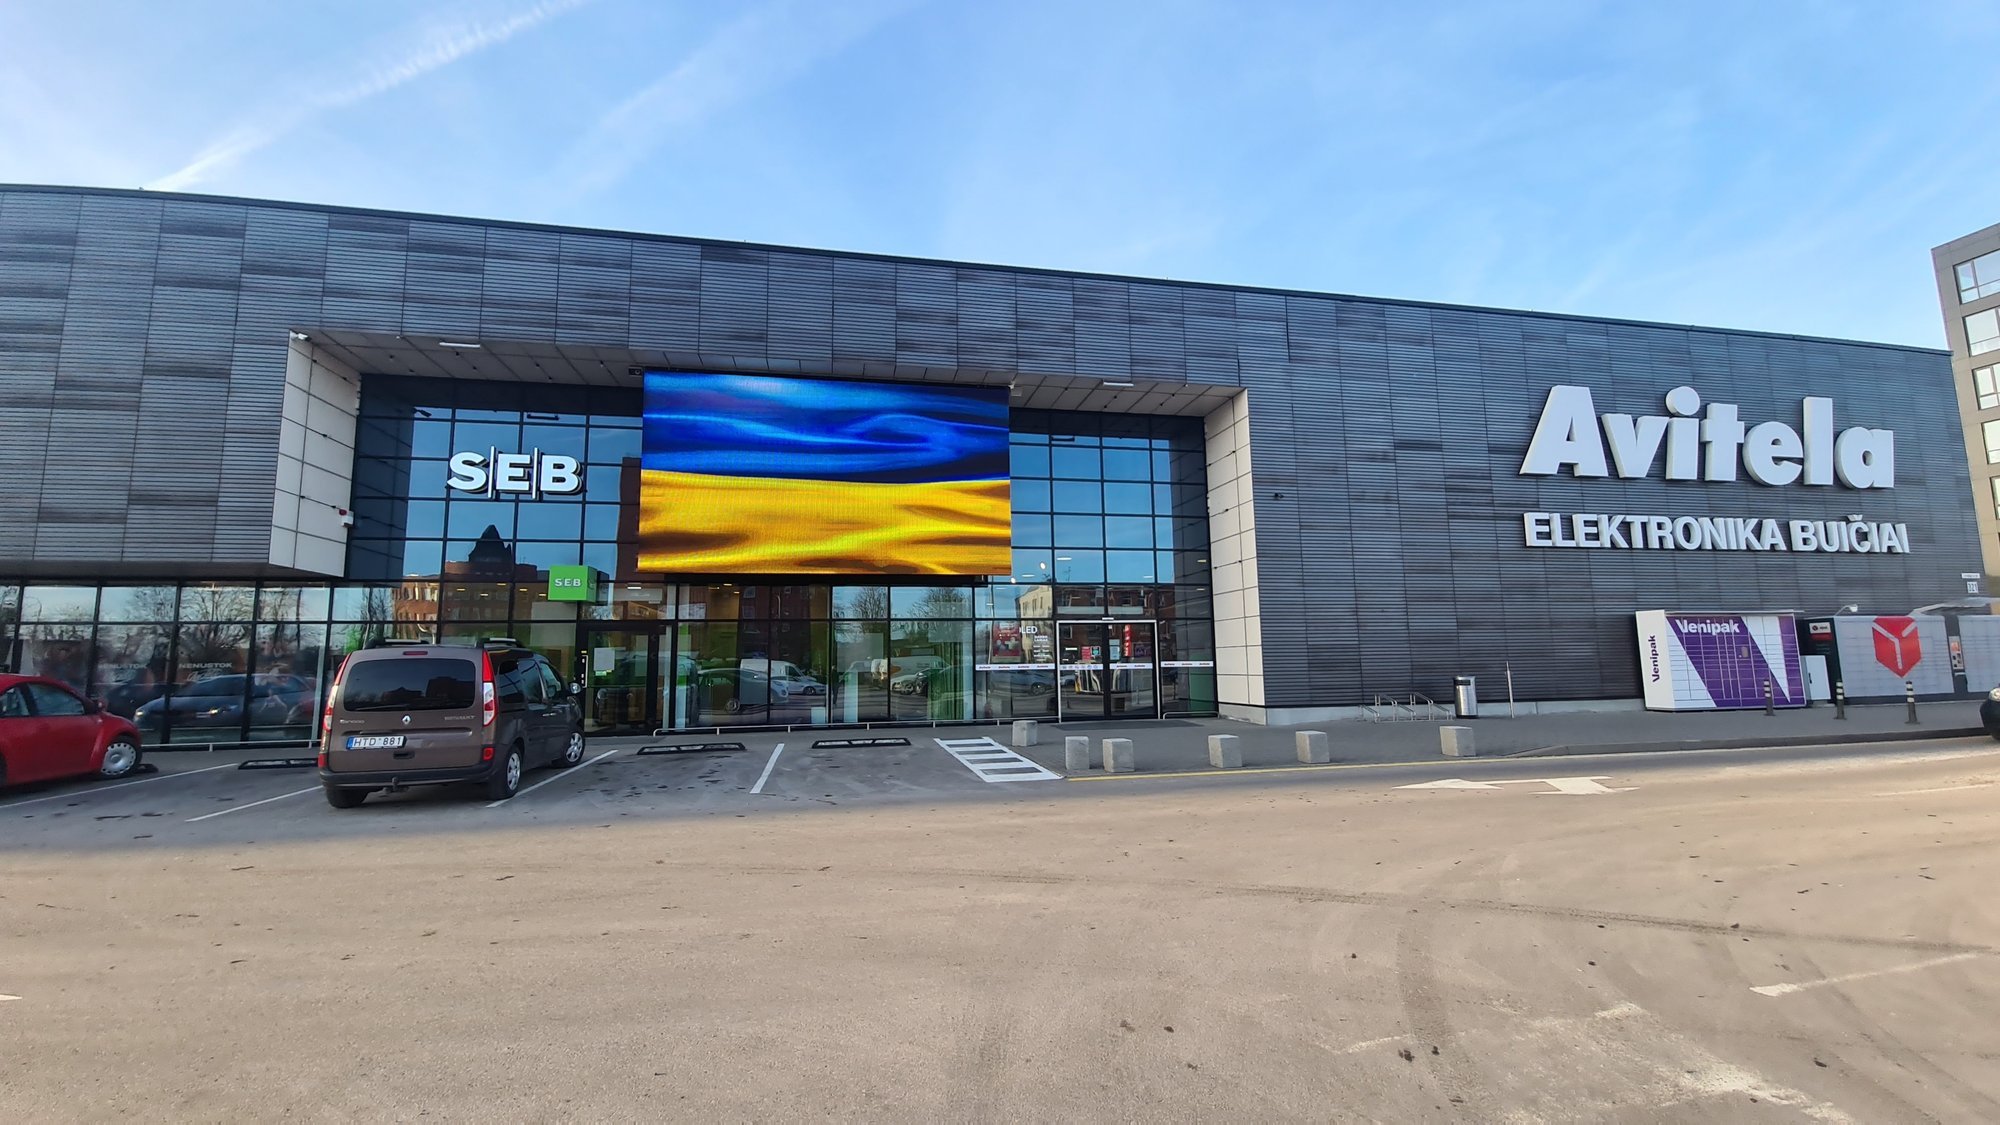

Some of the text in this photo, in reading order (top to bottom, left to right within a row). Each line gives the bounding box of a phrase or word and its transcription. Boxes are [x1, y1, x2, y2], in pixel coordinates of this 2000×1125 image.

[1519, 385, 1895, 489] Avitela
[447, 448, 583, 496] SEB
[1523, 512, 1912, 554] ELEKTRONIKA BUIČIAI
[554, 578, 582, 587] SEB
[1675, 619, 1740, 635] Venipak
[1648, 634, 1661, 683] Venipak
[353, 736, 401, 746] HTD 881
